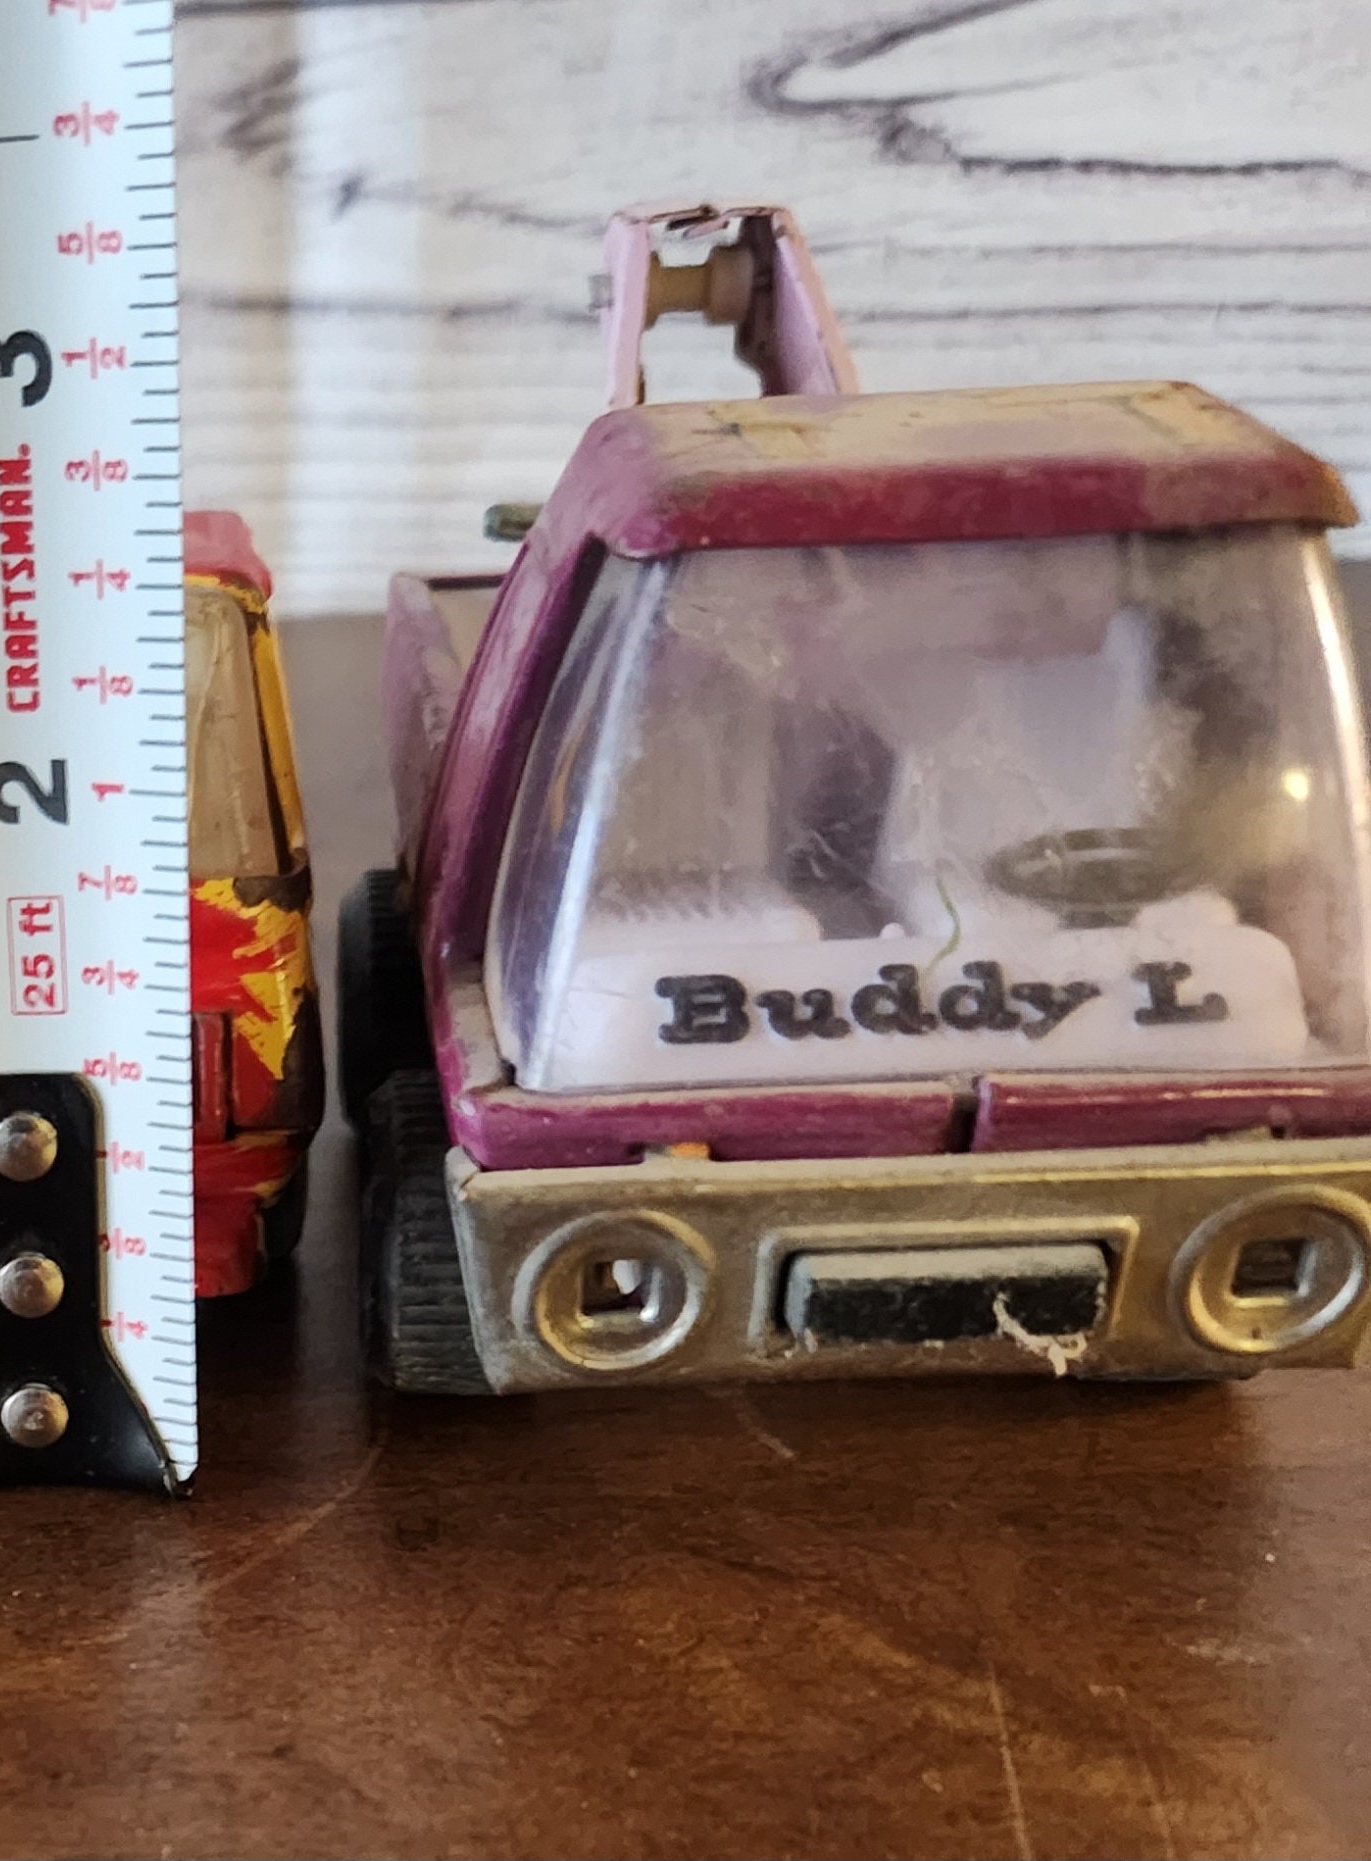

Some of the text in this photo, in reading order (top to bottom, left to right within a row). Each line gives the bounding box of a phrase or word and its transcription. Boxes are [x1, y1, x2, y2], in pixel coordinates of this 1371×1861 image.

[92, 782, 124, 800] 1
[19, 901, 56, 1008] 25 ft
[655, 960, 1227, 1044] Buddy L
